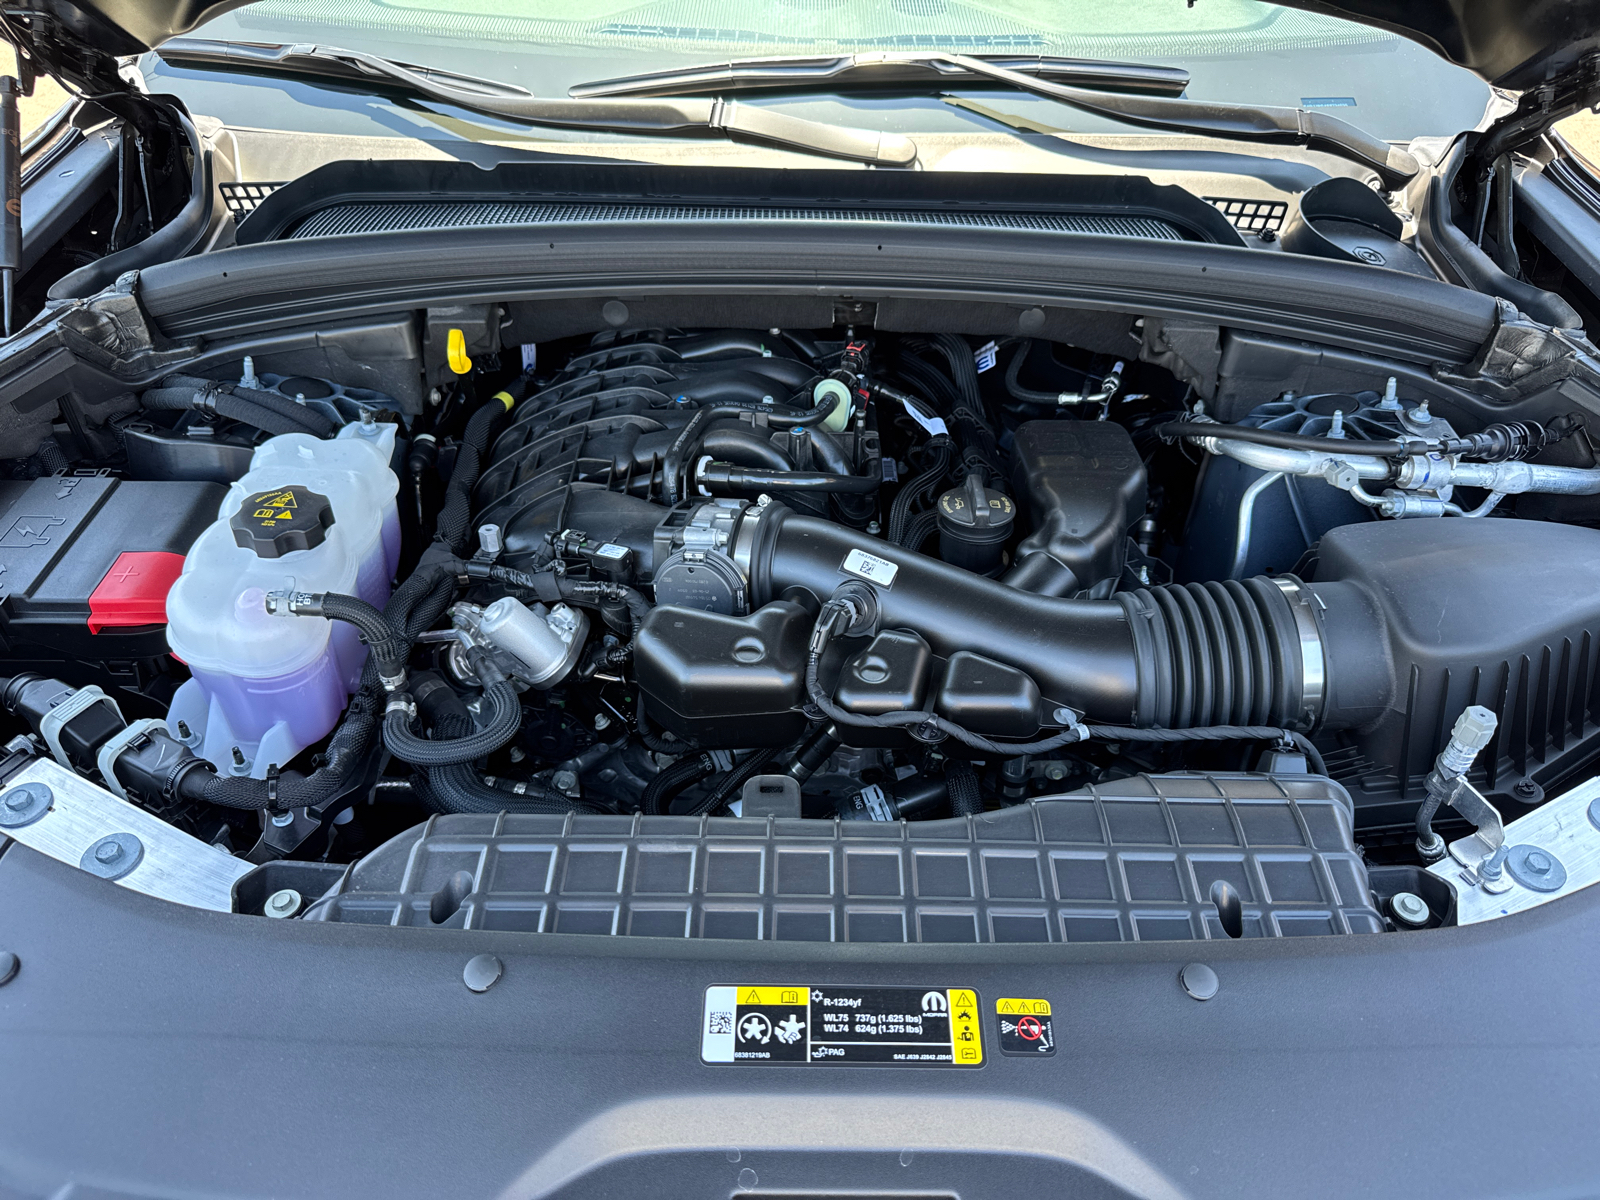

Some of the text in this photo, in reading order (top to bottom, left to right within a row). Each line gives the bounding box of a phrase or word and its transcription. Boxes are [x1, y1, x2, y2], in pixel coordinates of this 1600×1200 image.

[700, 753, 713, 770] ENG
[853, 795, 863, 810] ENG
[823, 998, 862, 1008] R-1234yf
[855, 1014, 876, 1023] 737g
[878, 1014, 904, 1023] (1.625
[905, 1015, 922, 1024] lbs)
[823, 1024, 923, 1035] WL74 624g (1.375 lbs)
[828, 1048, 845, 1057] PAG
